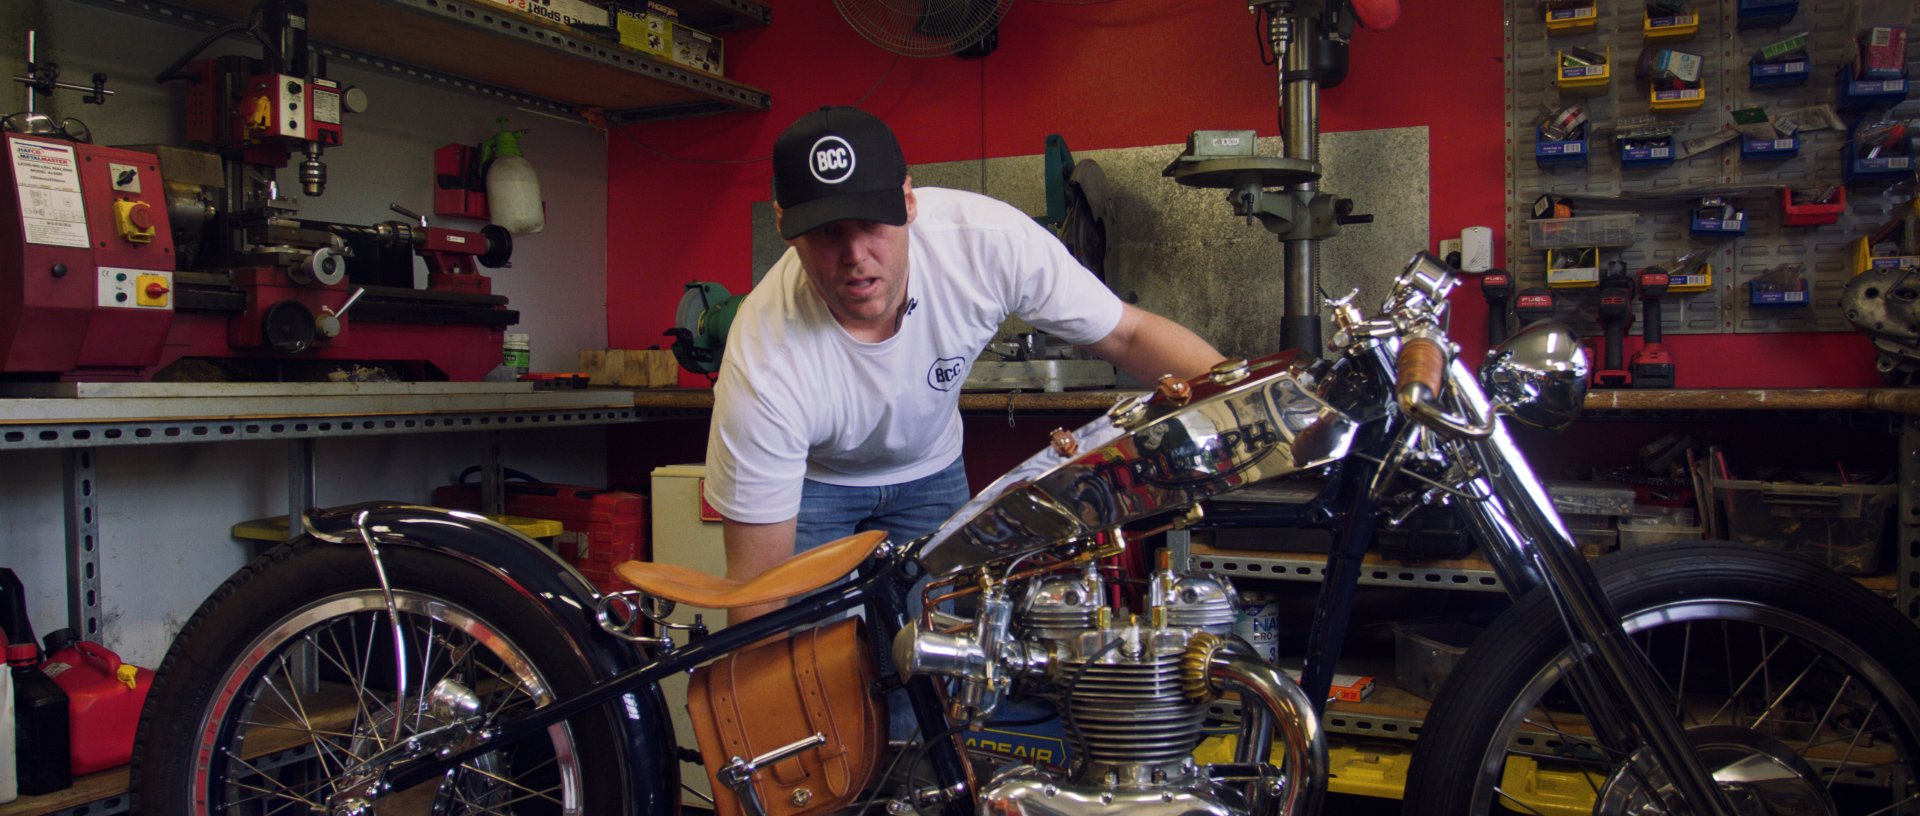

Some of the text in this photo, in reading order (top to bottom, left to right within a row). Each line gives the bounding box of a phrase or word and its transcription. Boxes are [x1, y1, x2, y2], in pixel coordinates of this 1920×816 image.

[528, 3, 561, 23] SPORT
[816, 147, 848, 172] BCC
[935, 362, 961, 383] BCC
[1253, 616, 1280, 632] NA
[1253, 632, 1273, 640] PRO
[965, 737, 1053, 764] ADEAIR
